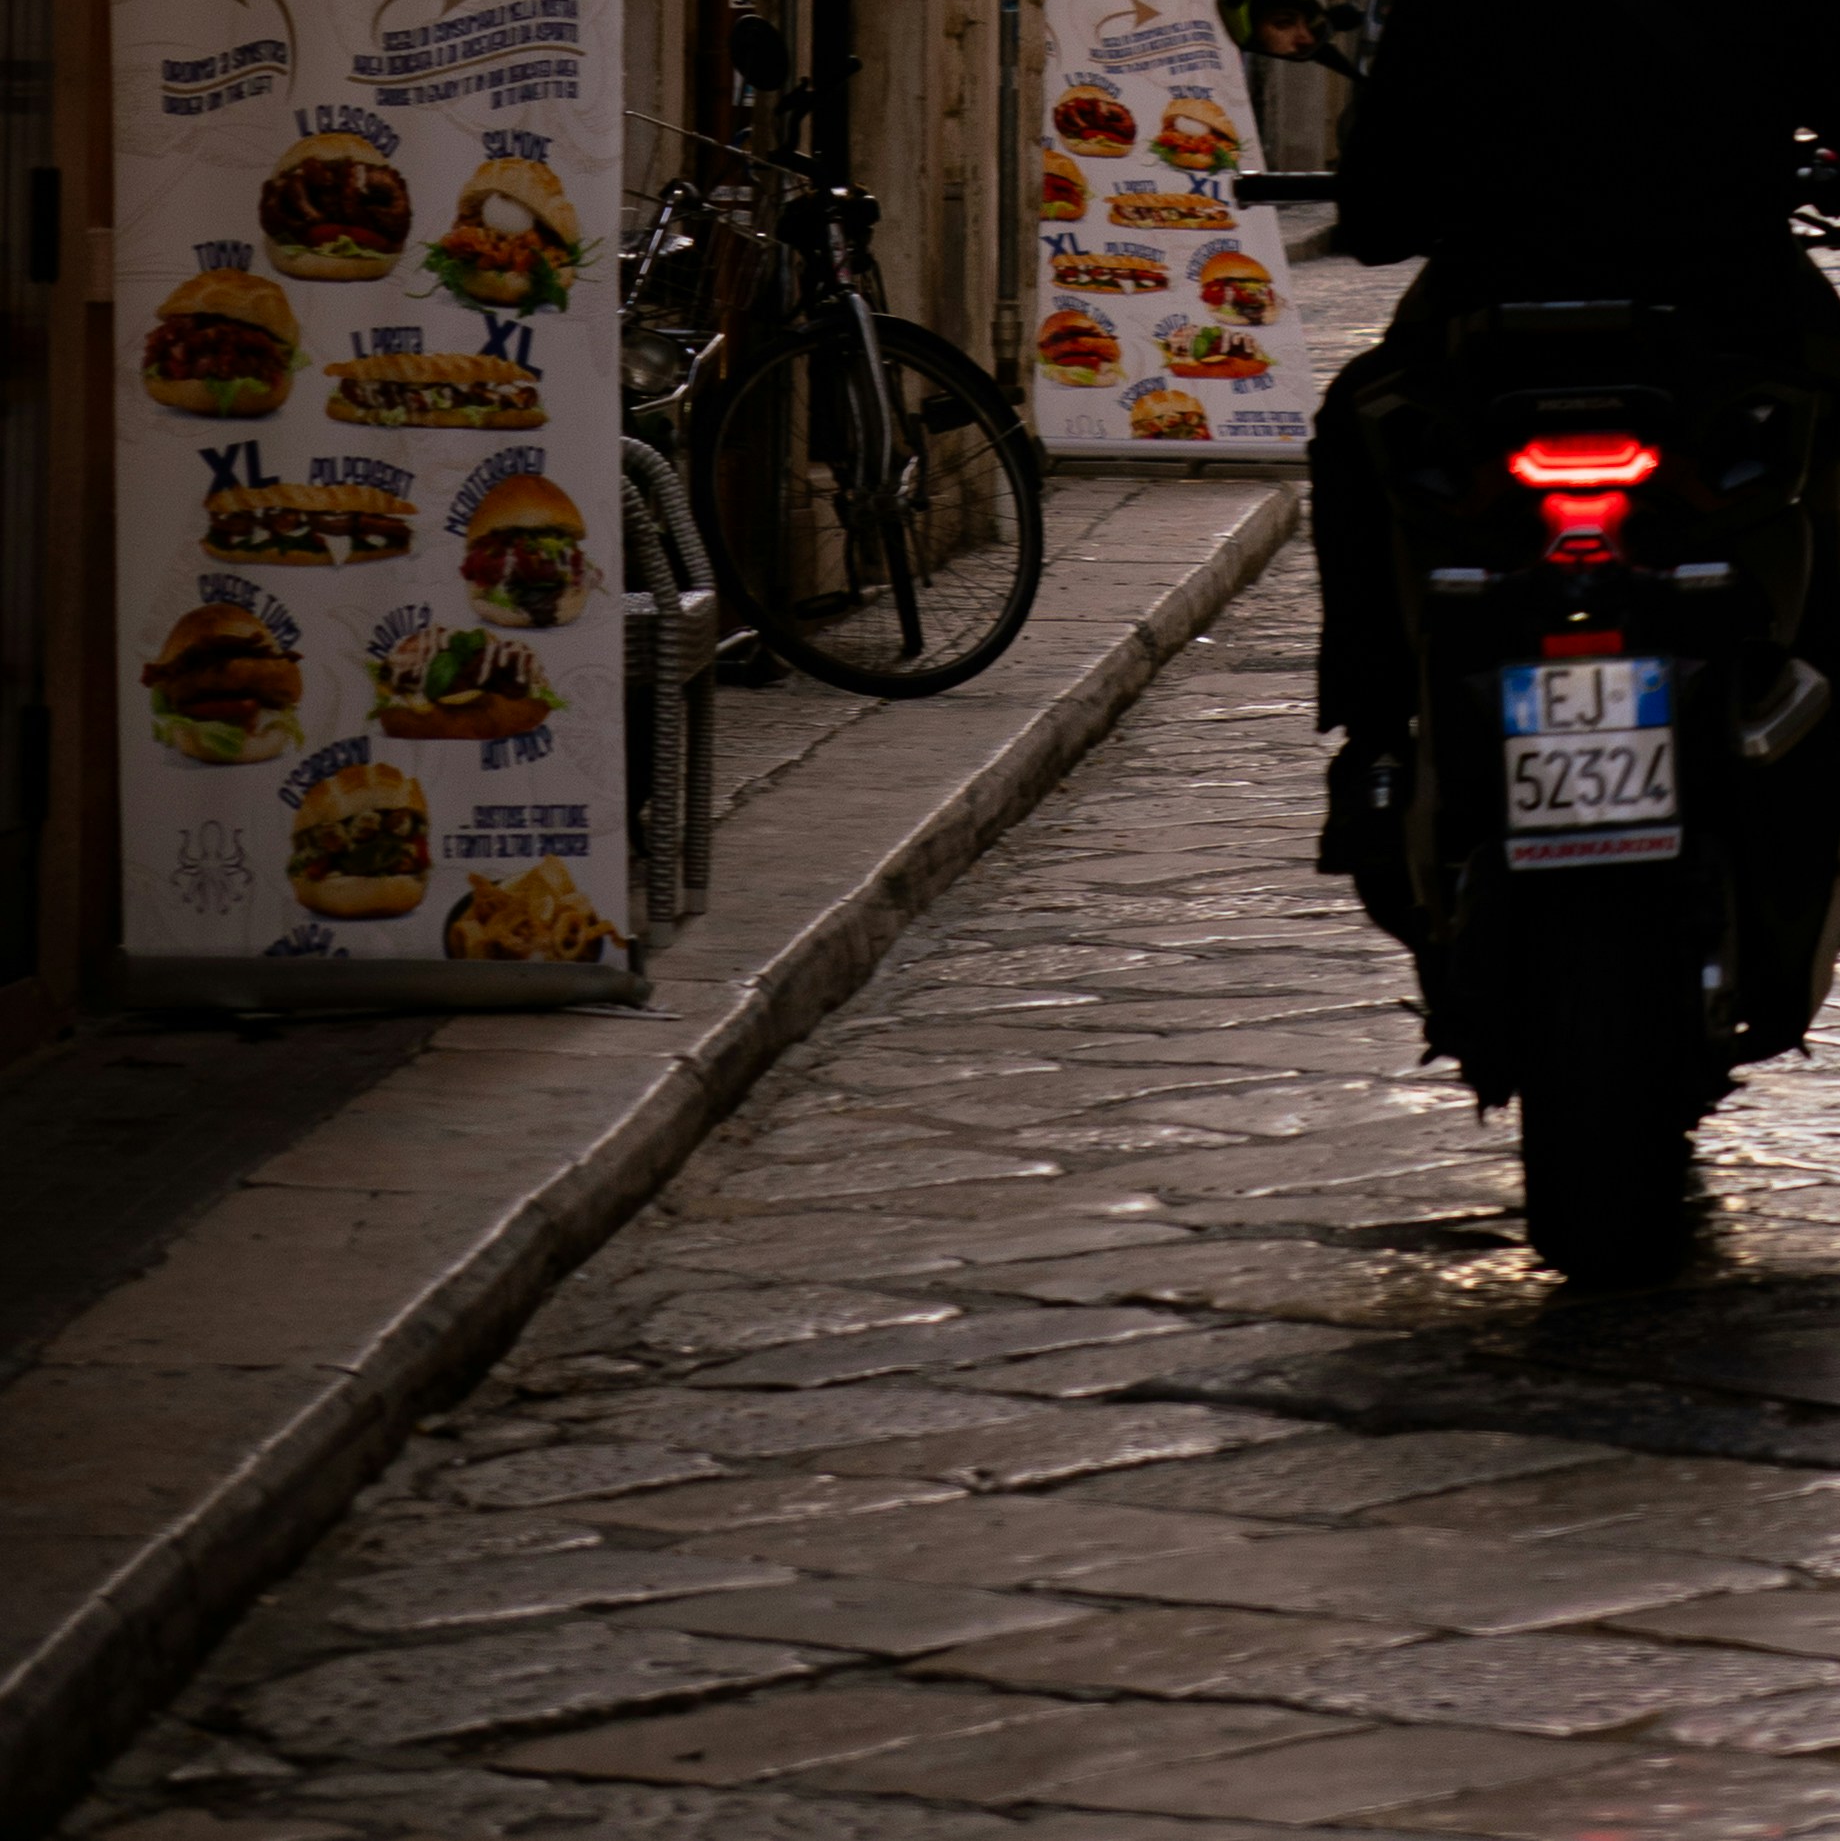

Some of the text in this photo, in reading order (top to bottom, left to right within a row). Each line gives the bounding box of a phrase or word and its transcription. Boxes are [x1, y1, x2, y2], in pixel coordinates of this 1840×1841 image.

[316, 104, 402, 160] CLASSICO
[1188, 173, 1231, 206] XL
[1040, 232, 1091, 257] XL
[480, 313, 543, 382] XL
[196, 439, 281, 492] XL
[1543, 667, 1606, 729] EJ
